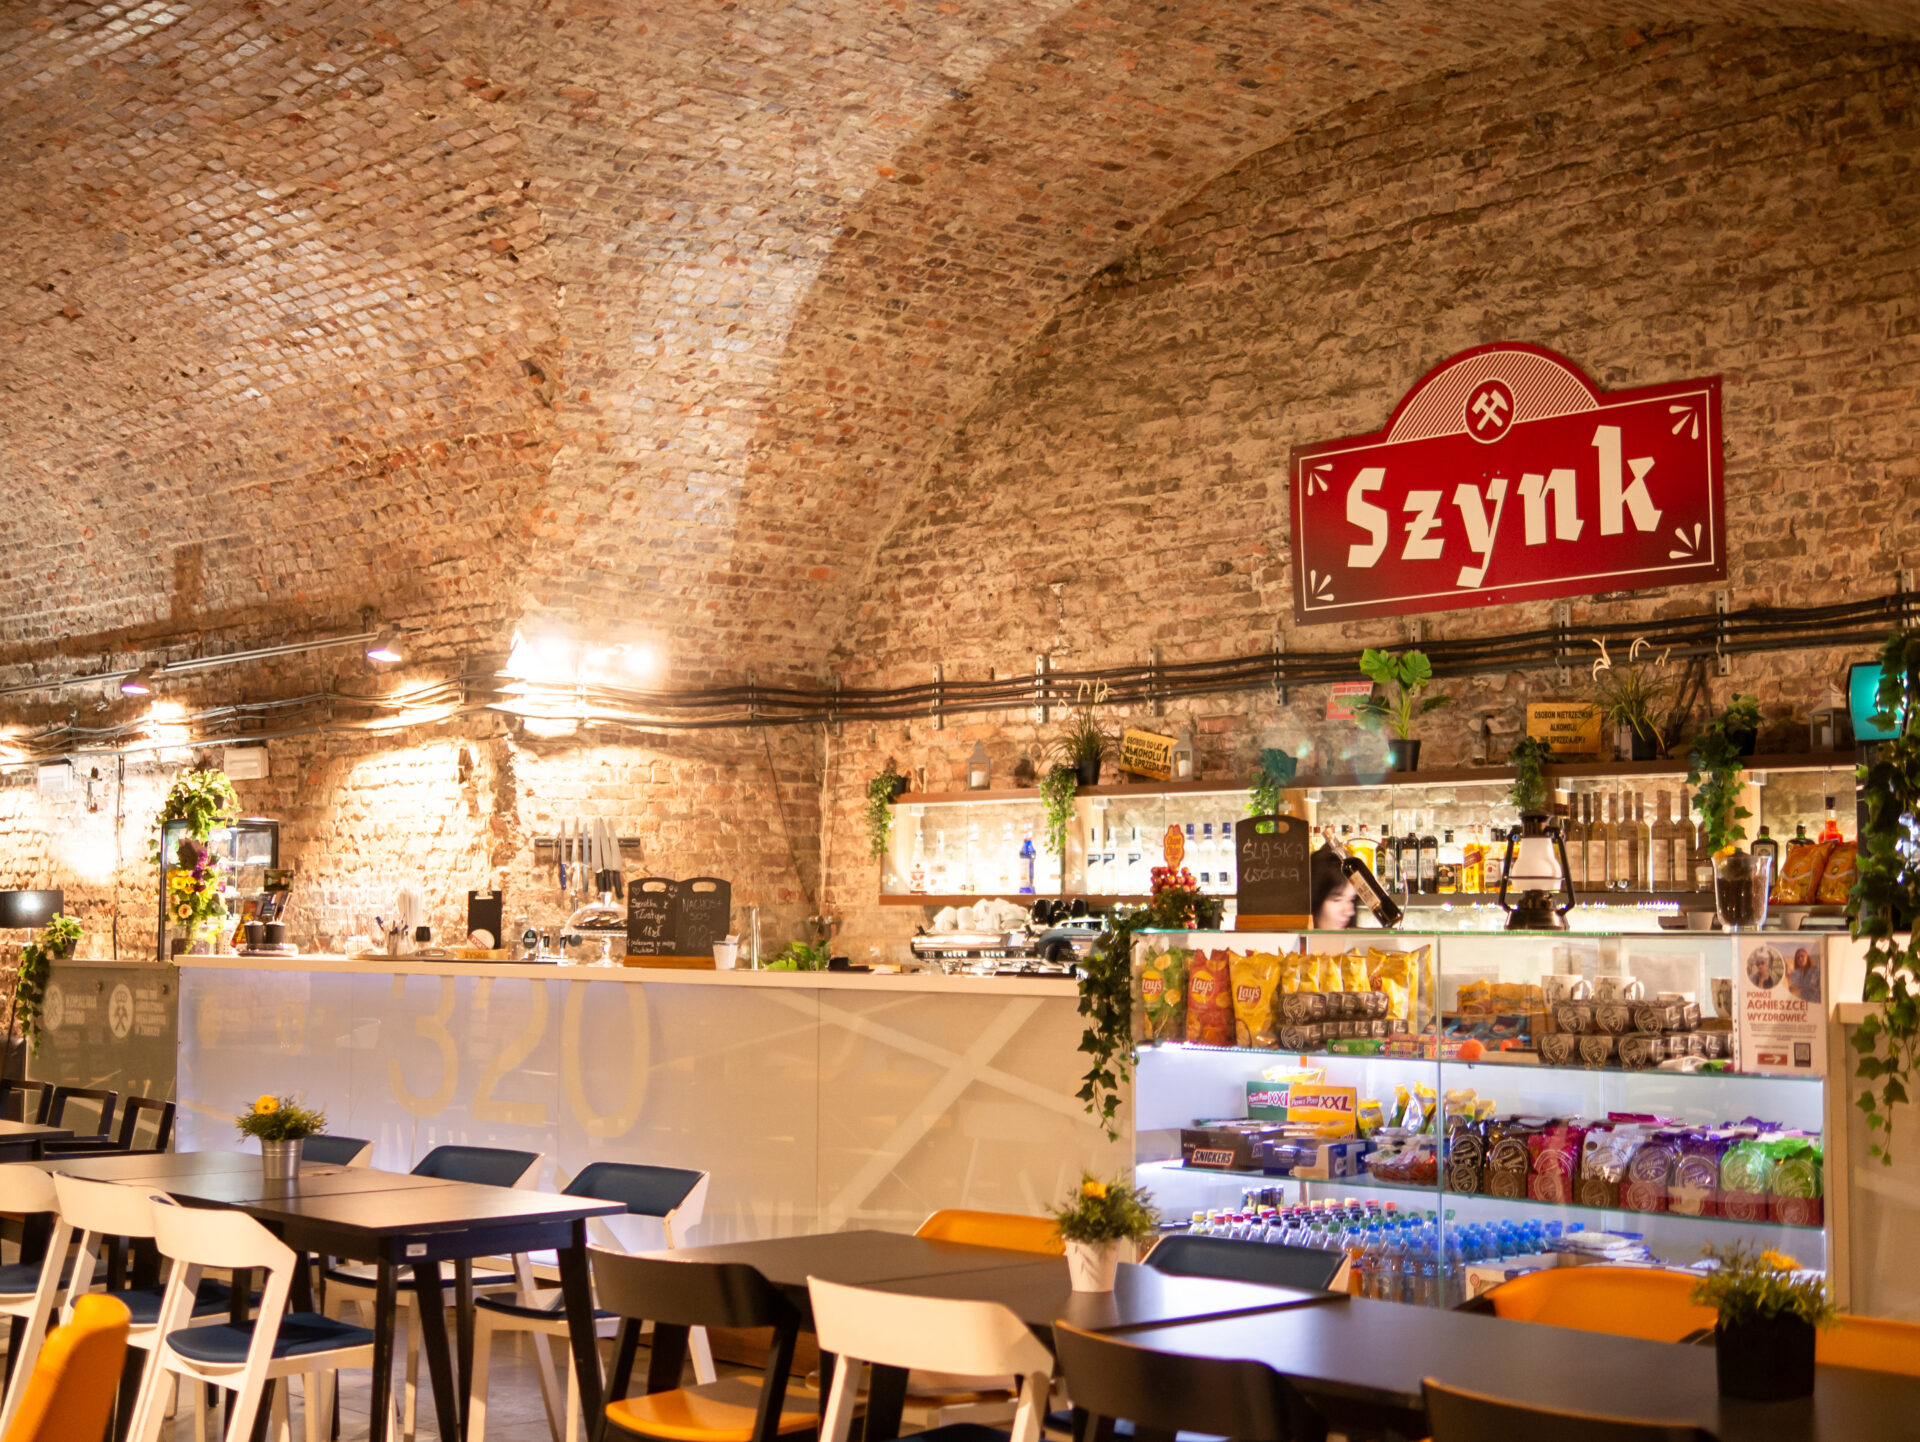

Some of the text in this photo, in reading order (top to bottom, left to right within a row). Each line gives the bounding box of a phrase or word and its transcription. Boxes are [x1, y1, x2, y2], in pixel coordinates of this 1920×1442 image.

[1346, 425, 1663, 588] Szynk
[1191, 977, 1214, 998] Lay's
[1237, 985, 1261, 1004] Lay's
[1320, 1096, 1352, 1112] XXL
[1193, 1150, 1233, 1164] SNICKERS
